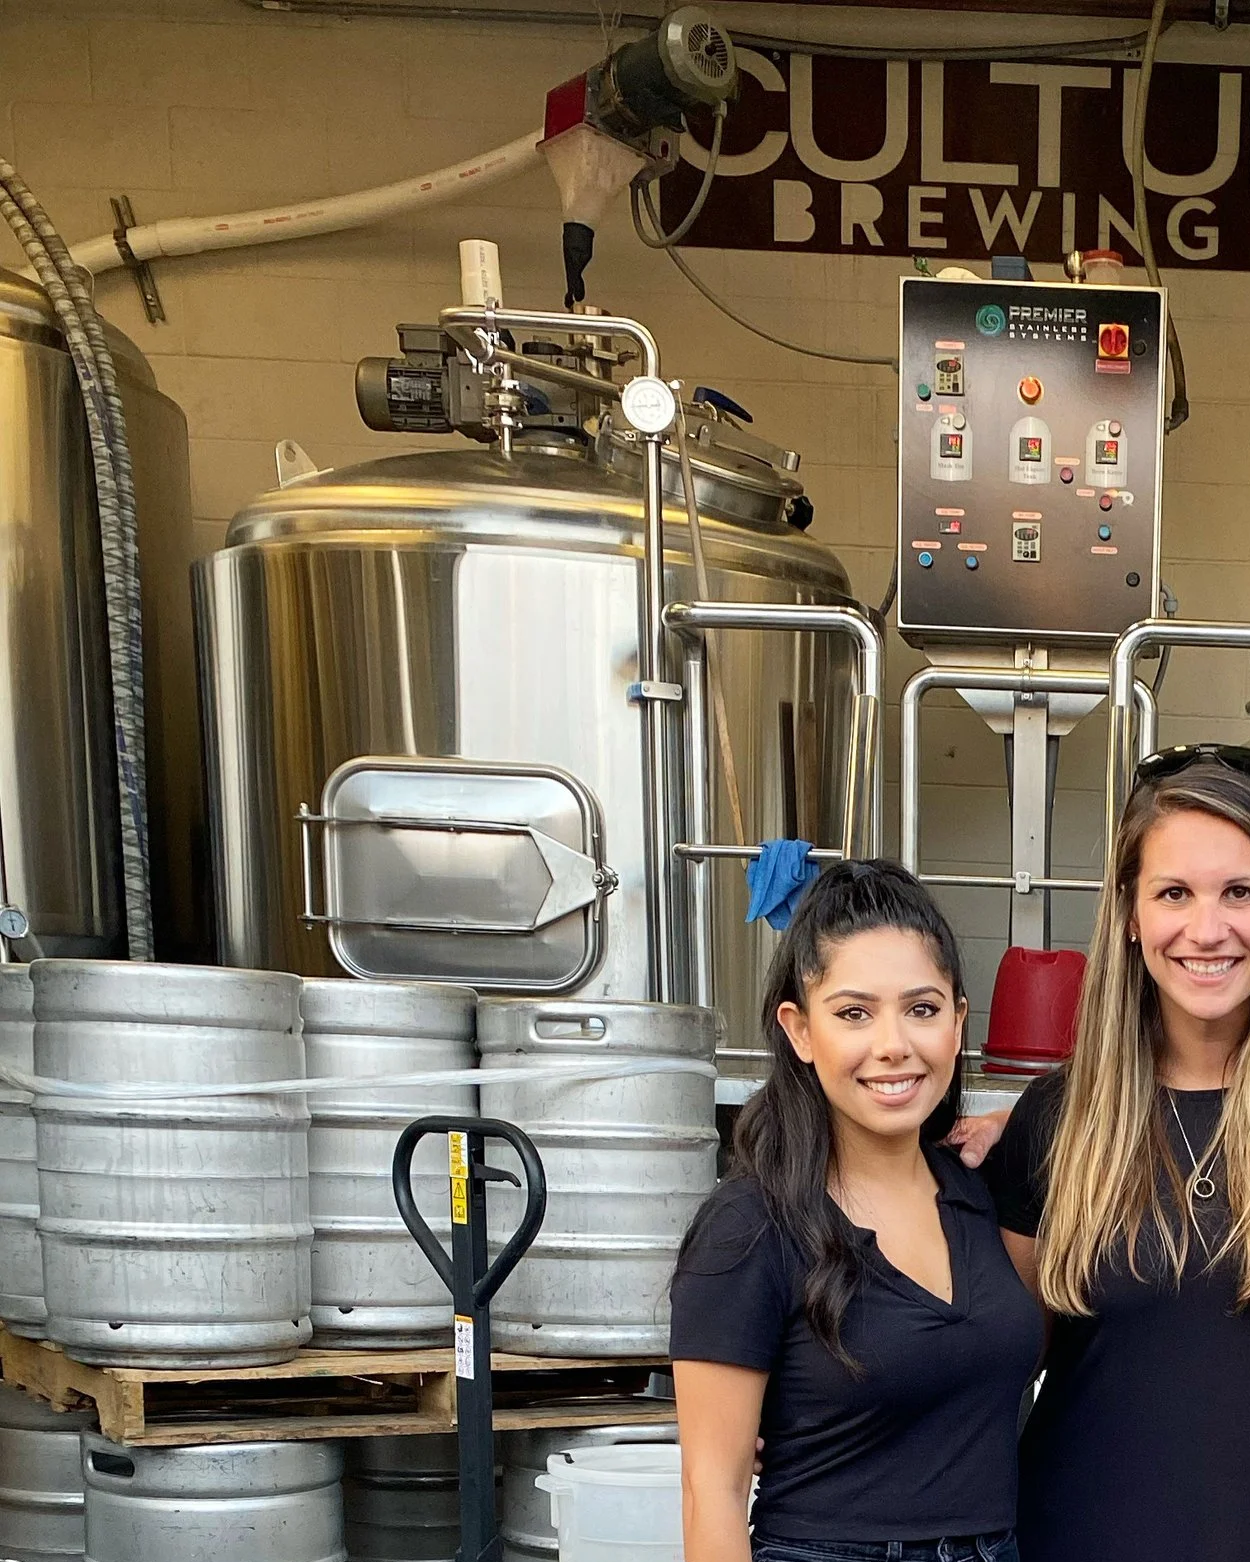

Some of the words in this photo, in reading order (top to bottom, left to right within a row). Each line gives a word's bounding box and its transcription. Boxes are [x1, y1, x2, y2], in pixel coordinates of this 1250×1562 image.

[774, 179, 1220, 262] BREWING
[1009, 305, 1087, 323] PREMIER
[1009, 323, 1087, 334] STAINLESS
[1009, 332, 1087, 341] SYSTEMS
